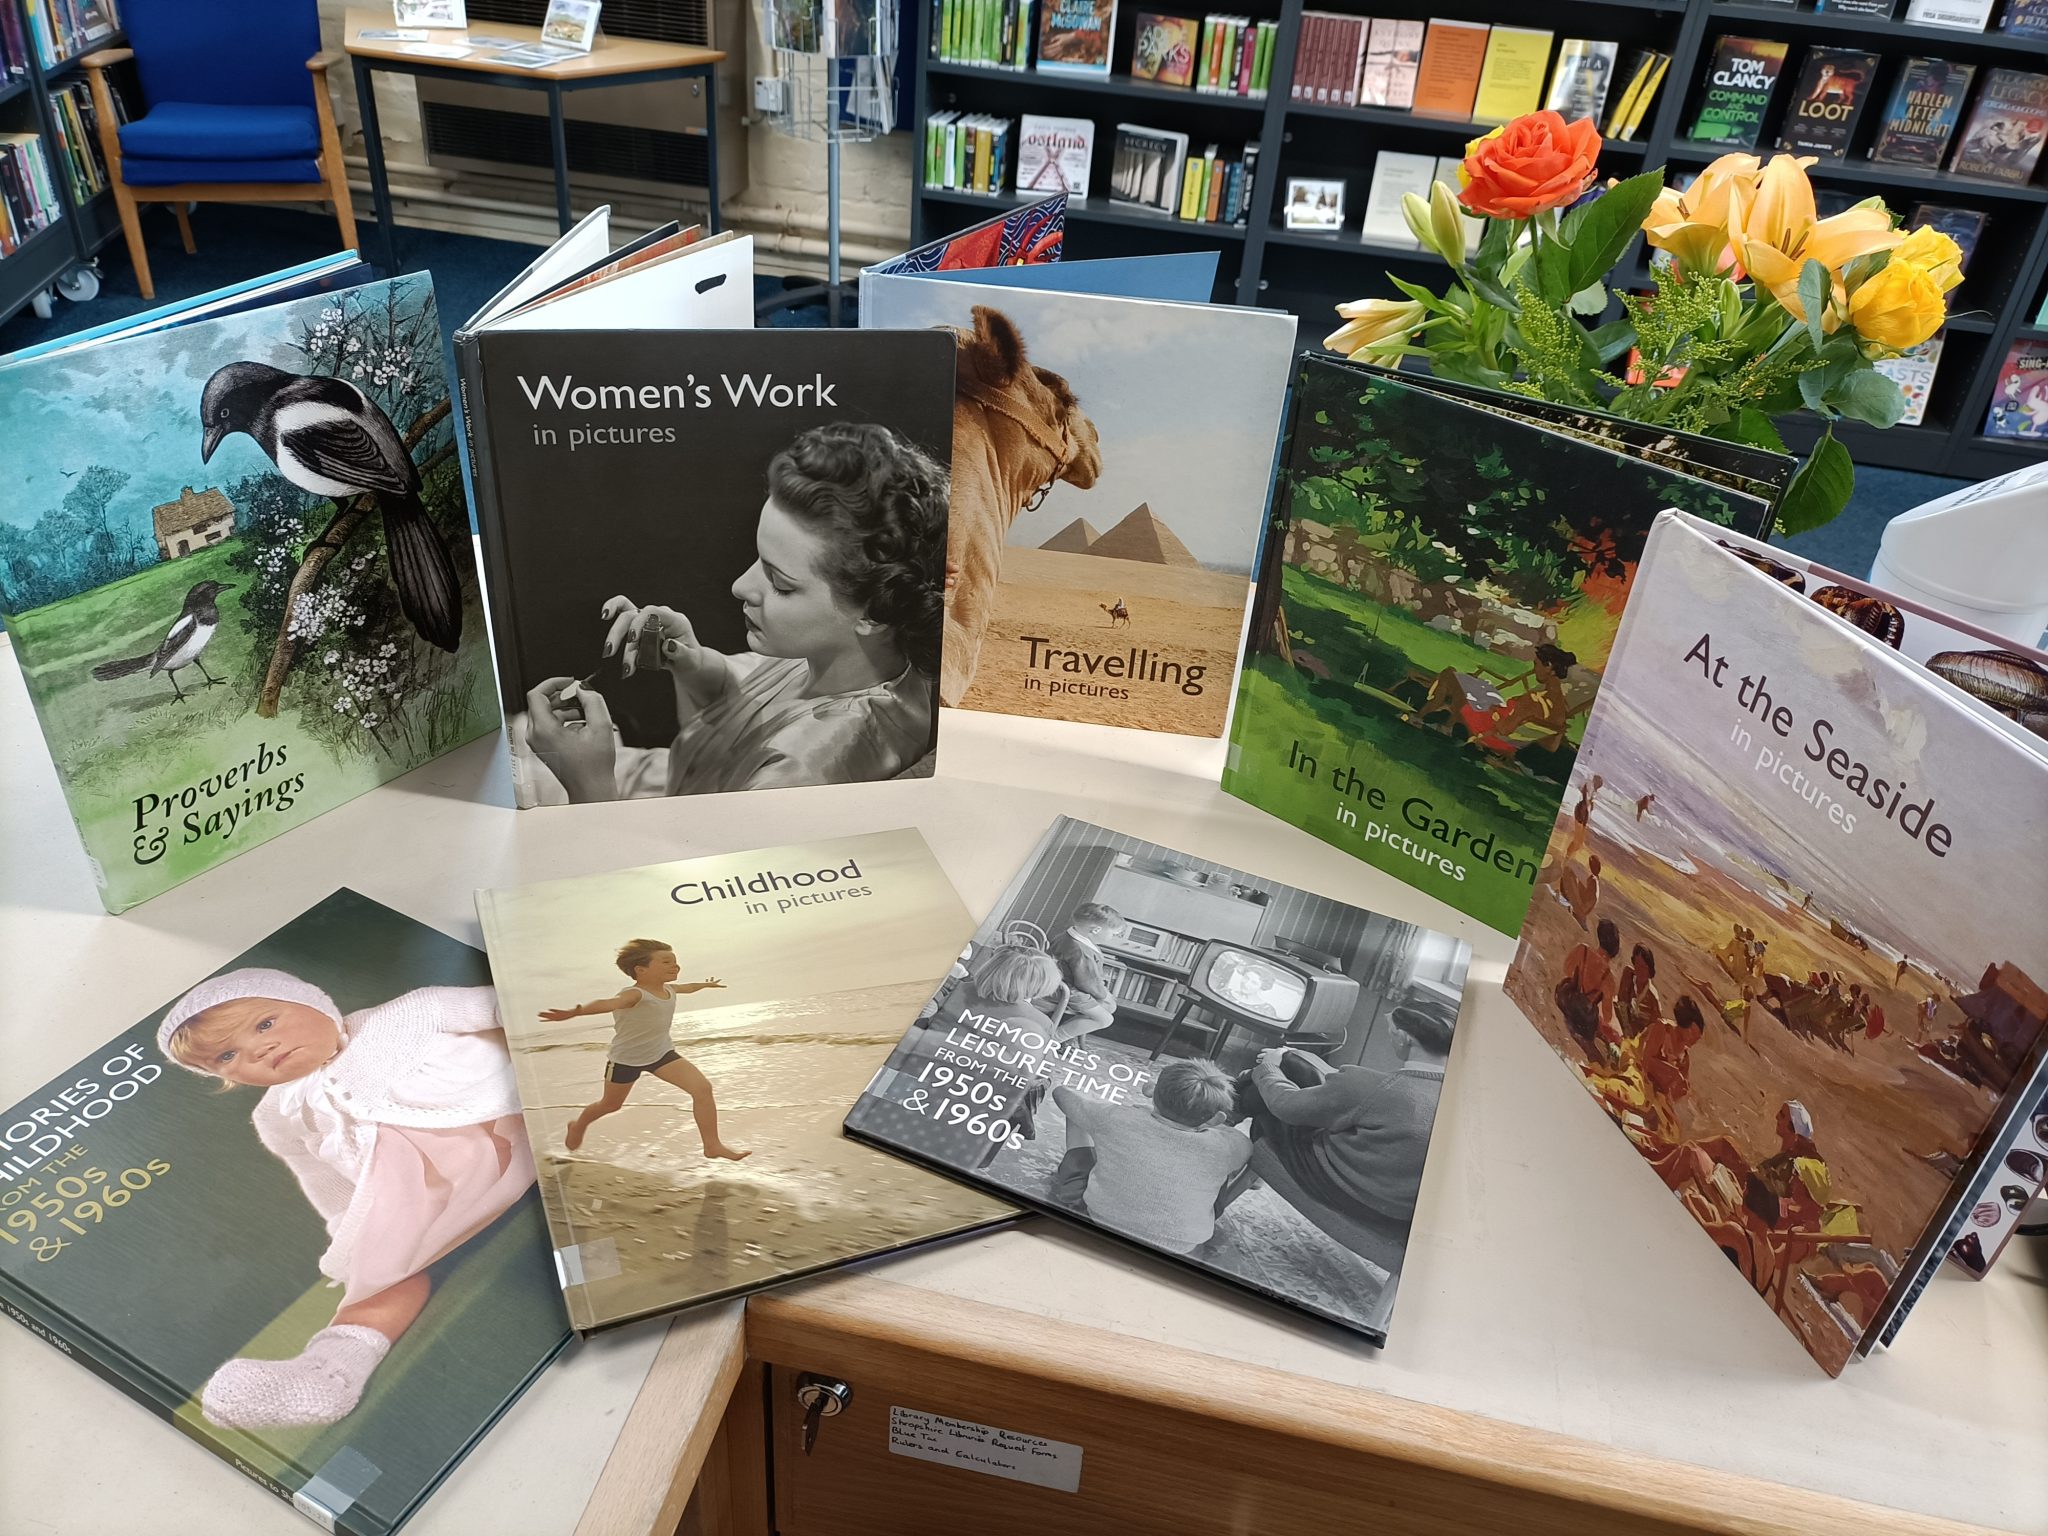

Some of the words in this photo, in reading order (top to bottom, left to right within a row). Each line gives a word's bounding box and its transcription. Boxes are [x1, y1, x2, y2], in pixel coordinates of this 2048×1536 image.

[1060, 0, 1095, 15] CLAIRE
[1713, 70, 1776, 90] CLANCY
[1731, 57, 1765, 75] TOM
[1703, 107, 1759, 124] CONTROL
[1708, 89, 1768, 105] COMMAND
[1726, 102, 1745, 111] AND
[1799, 100, 1854, 121] LOOT
[1906, 90, 1953, 109] HARLEM
[1906, 105, 1944, 121] AFTER
[1889, 119, 1950, 137] MIDNIGHT
[460, 378, 470, 414] Women's
[465, 415, 474, 438] Work
[516, 373, 712, 410] Women's
[720, 373, 838, 407] Work
[533, 424, 557, 445] in
[568, 423, 677, 451] pictures
[1020, 636, 1207, 696] Travelling
[1024, 674, 1041, 691] in
[1049, 679, 1129, 700] pictures
[1683, 633, 1729, 688] At
[1737, 675, 1793, 737] the
[1803, 719, 1952, 858] Seaside
[132, 742, 287, 833] Proverbs
[1730, 718, 1752, 751] in
[1754, 746, 1857, 834] pictures
[133, 826, 169, 865] &
[183, 772, 305, 845] Sayings
[1288, 740, 1317, 779] In
[1332, 767, 1386, 811] the
[1401, 797, 1538, 885] Garden
[1335, 802, 1357, 828] in
[1364, 821, 1466, 882] pictures
[670, 858, 862, 905] Childhood
[744, 901, 768, 914] in
[776, 886, 873, 914] pictures
[934, 1047, 988, 1074] FROM
[990, 1067, 1029, 1090] THE
[945, 1028, 1055, 1079] LEISURE
[1061, 1068, 1128, 1106] TIME
[957, 1008, 1100, 1071] MEMORIES
[1108, 1063, 1151, 1087] OF
[0, 1077, 100, 1151] ORIES
[102, 1043, 145, 1076] OF
[917, 1062, 1007, 1112] 1950s
[0, 1064, 162, 1182] ILDHOOD
[902, 1088, 931, 1115] &
[933, 1098, 1025, 1151] 1960s
[39, 1143, 89, 1174] THE
[0, 1166, 108, 1245] 1950s
[29, 1236, 73, 1262] &
[59, 1158, 172, 1236] 1960s
[7, 1305, 29, 1326] 1950s
[31, 1323, 45, 1337] and
[48, 1333, 72, 1355] 1960s
[891, 1416, 943, 1434] Shropshire
[1031, 1447, 1058, 1460] Forms
[892, 1408, 930, 1425] Library
[935, 1417, 989, 1436] Membership
[999, 1430, 1048, 1447] Resources
[891, 1436, 923, 1450] Rulers
[955, 1450, 1016, 1470] Calculators
[235, 1458, 268, 1486] Pictures
[269, 1483, 279, 1493] to
